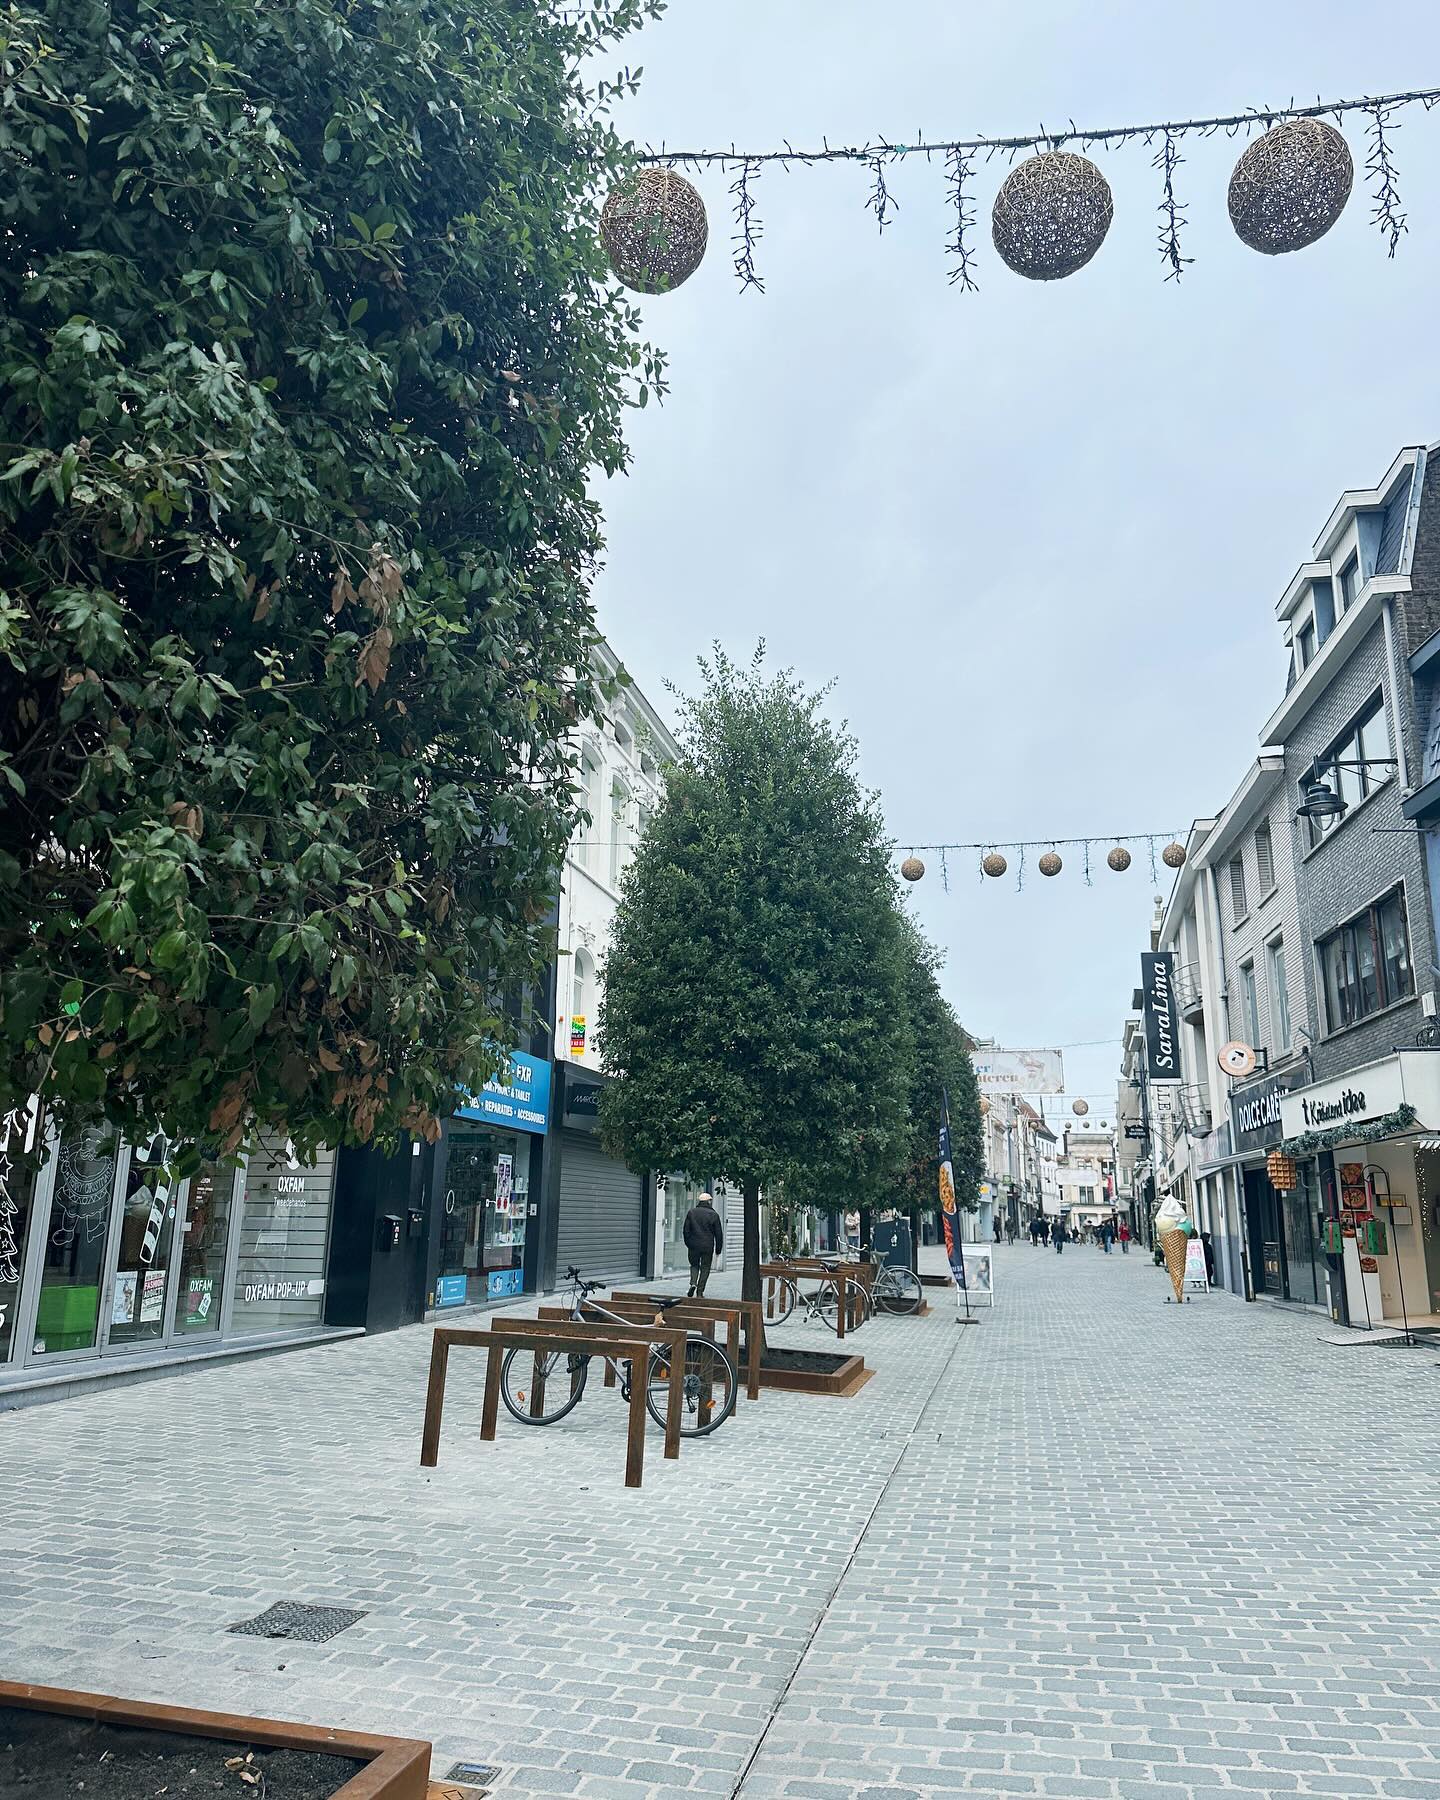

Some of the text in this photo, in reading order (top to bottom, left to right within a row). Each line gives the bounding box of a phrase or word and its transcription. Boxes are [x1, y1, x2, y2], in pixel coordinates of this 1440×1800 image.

[1151, 961, 1173, 1069] SaraLina
[484, 1100, 513, 1117] REPARATIES
[517, 1108, 545, 1125] ACCESSOIRES
[1239, 1085, 1289, 1133] DOLCE CARÊ
[278, 1176, 304, 1193] OXFAM
[189, 1279, 213, 1292] OXFAM
[245, 1281, 305, 1302] OXFAM POP-UP
